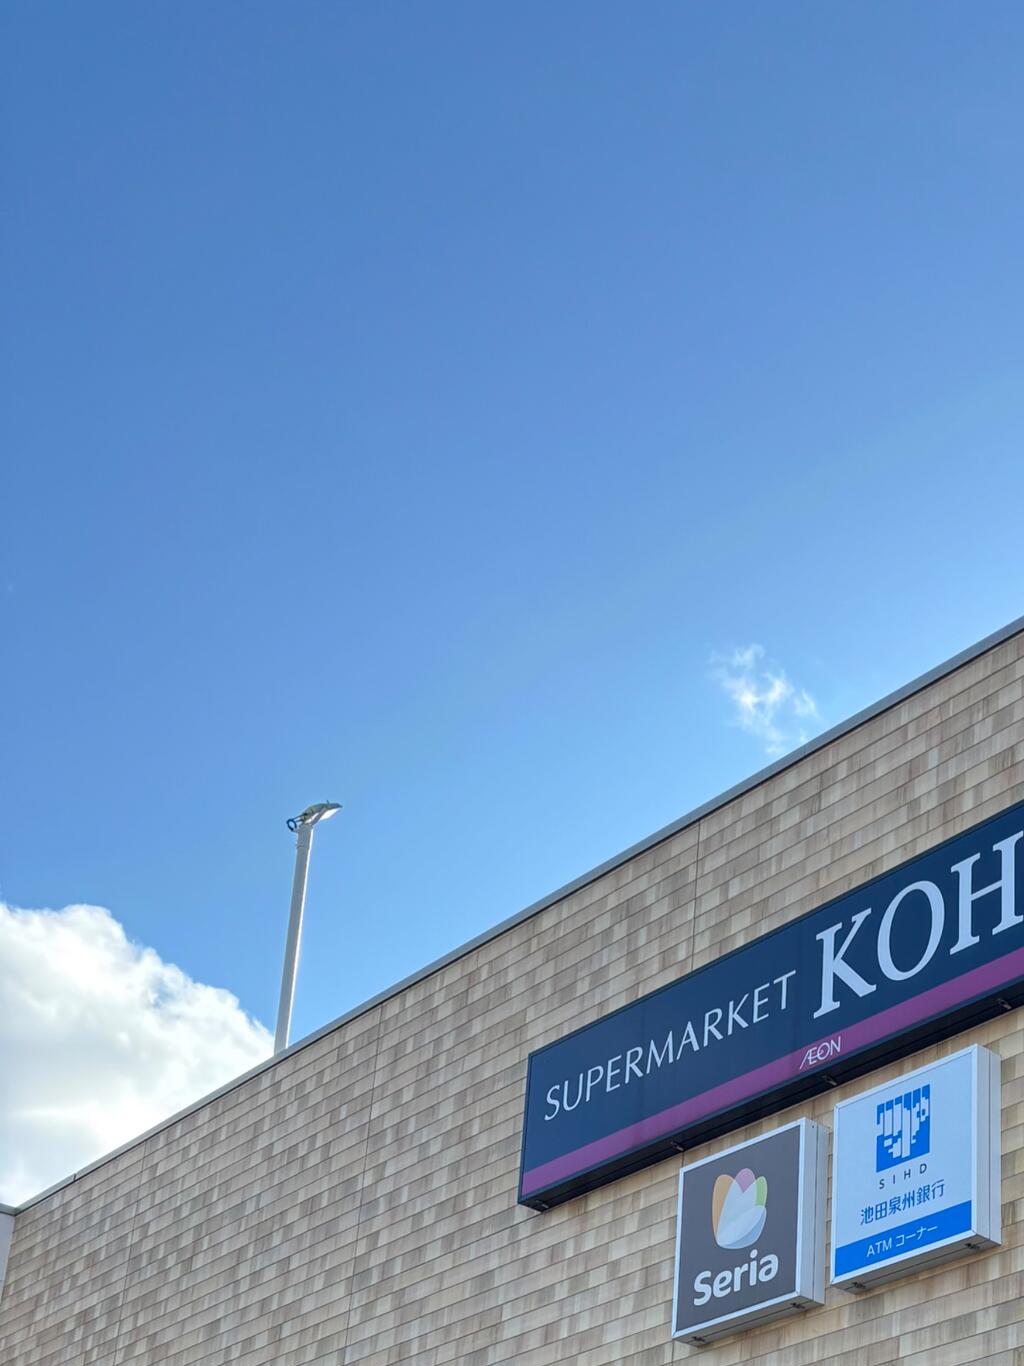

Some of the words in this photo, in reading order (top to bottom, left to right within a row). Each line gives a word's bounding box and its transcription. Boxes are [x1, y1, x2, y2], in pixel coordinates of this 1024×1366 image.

[544, 970, 796, 1121] SUPERMARKET
[860, 1179, 945, 1225] 池田泉州銀行
[693, 1249, 778, 1306] Seria
